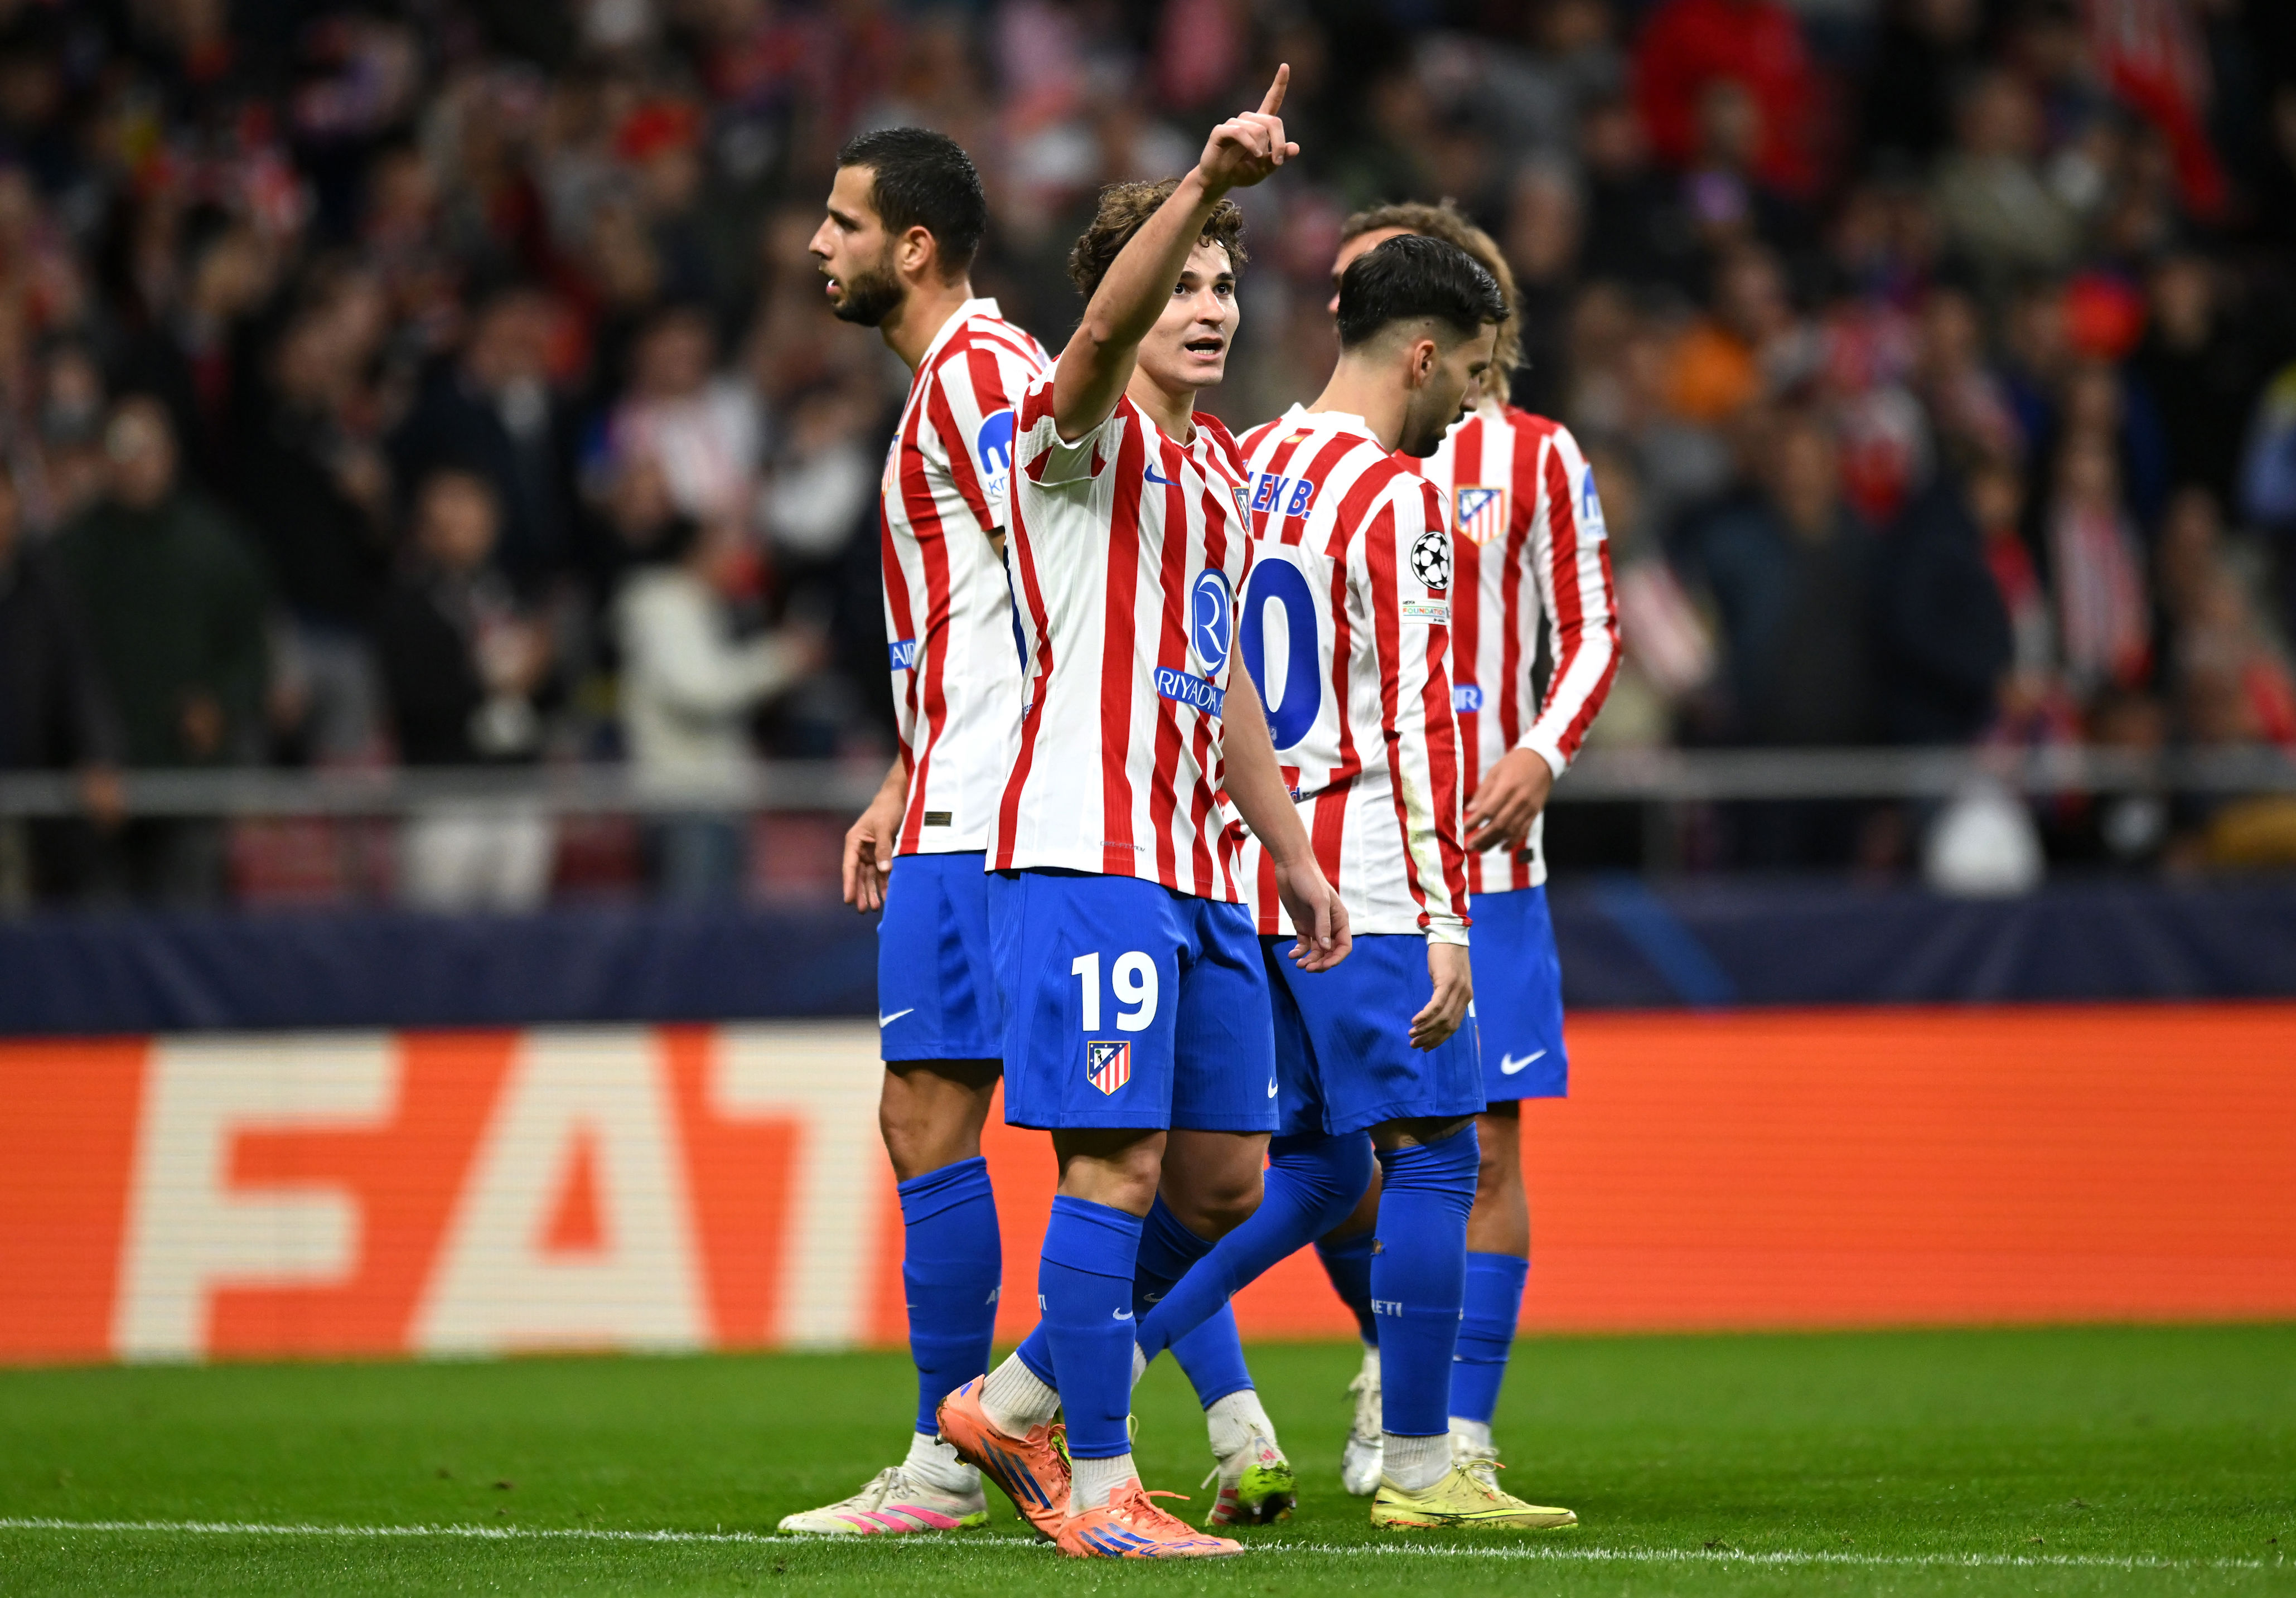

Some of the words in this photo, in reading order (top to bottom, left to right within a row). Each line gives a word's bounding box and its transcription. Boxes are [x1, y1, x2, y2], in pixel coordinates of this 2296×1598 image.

[1285, 480, 1311, 520] B.
[1158, 670, 1216, 712] RIYADH
[1071, 951, 1158, 1032] 19
